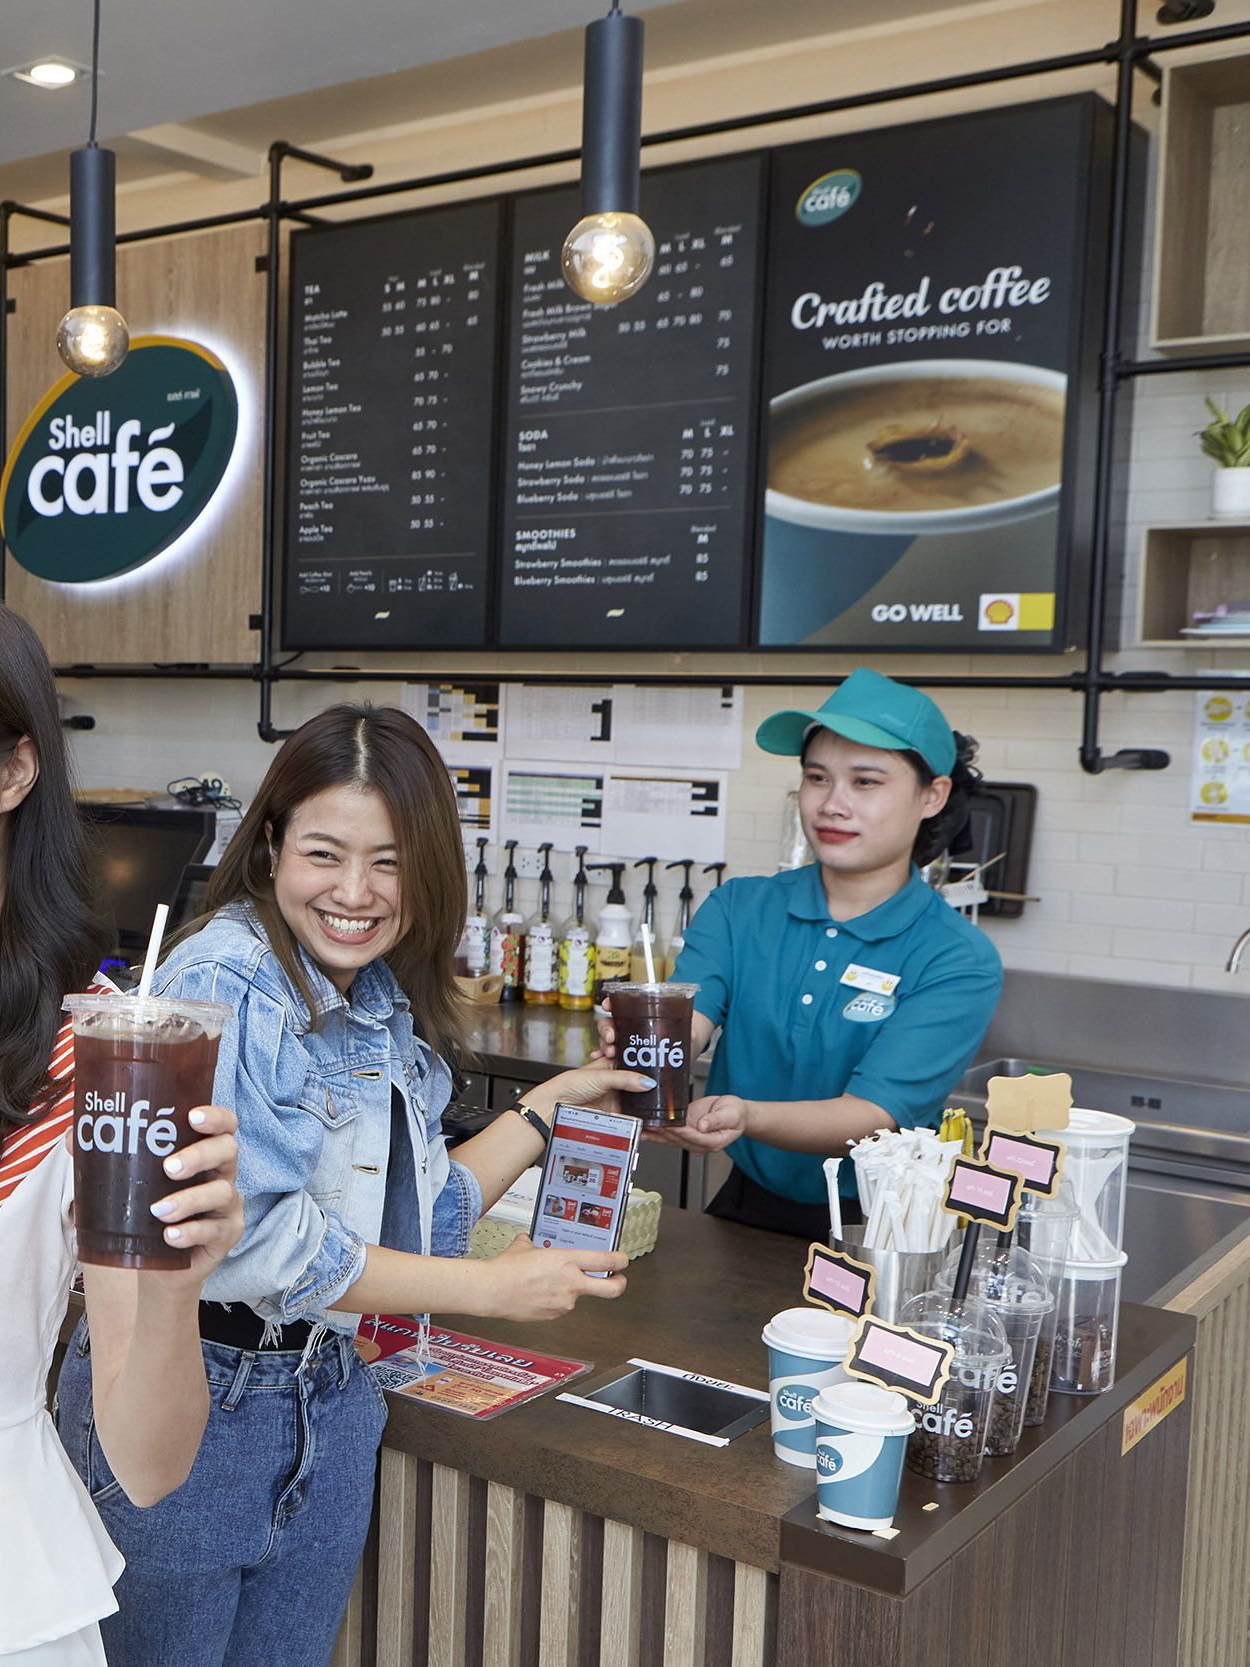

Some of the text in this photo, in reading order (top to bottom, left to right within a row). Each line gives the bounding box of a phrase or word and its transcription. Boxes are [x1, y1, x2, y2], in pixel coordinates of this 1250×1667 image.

[805, 186, 850, 212] café
[524, 250, 550, 262] MILK
[304, 285, 320, 294] TEA
[791, 265, 1051, 330] Crafted coffee
[522, 329, 587, 345] Strawberry Milk
[822, 318, 1012, 350] WORTH STOPPING FOR
[521, 358, 553, 370] Cookies
[563, 355, 591, 365] Cream
[302, 404, 361, 418] Honey Lemon Tea
[49, 410, 110, 450] Shell
[318, 430, 330, 439] Tea
[518, 430, 548, 441] SODA
[300, 454, 328, 465] Organic
[518, 461, 544, 472] Honey
[545, 459, 571, 469] Lemon
[573, 457, 595, 467] Soda
[27, 419, 185, 517] café
[300, 478, 328, 489] Organic
[518, 476, 561, 488] Strawberry
[563, 474, 585, 484] Soda
[517, 492, 555, 504] Blueberry
[557, 491, 578, 501] Soda
[300, 501, 334, 511] Peach Tea
[299, 524, 333, 536] Apple Tea
[516, 528, 576, 540] SMOOTHIES
[515, 559, 559, 570] Strawberry
[560, 557, 601, 568] Smoothies
[514, 576, 552, 587] Blueberry
[554, 574, 595, 585] Smoothies
[871, 603, 964, 622] GO WELL
[629, 1034, 657, 1046] Shell
[622, 1039, 684, 1068] café
[85, 1091, 125, 1113] Shell
[77, 1100, 177, 1157] café
[952, 1364, 1018, 1394] afé
